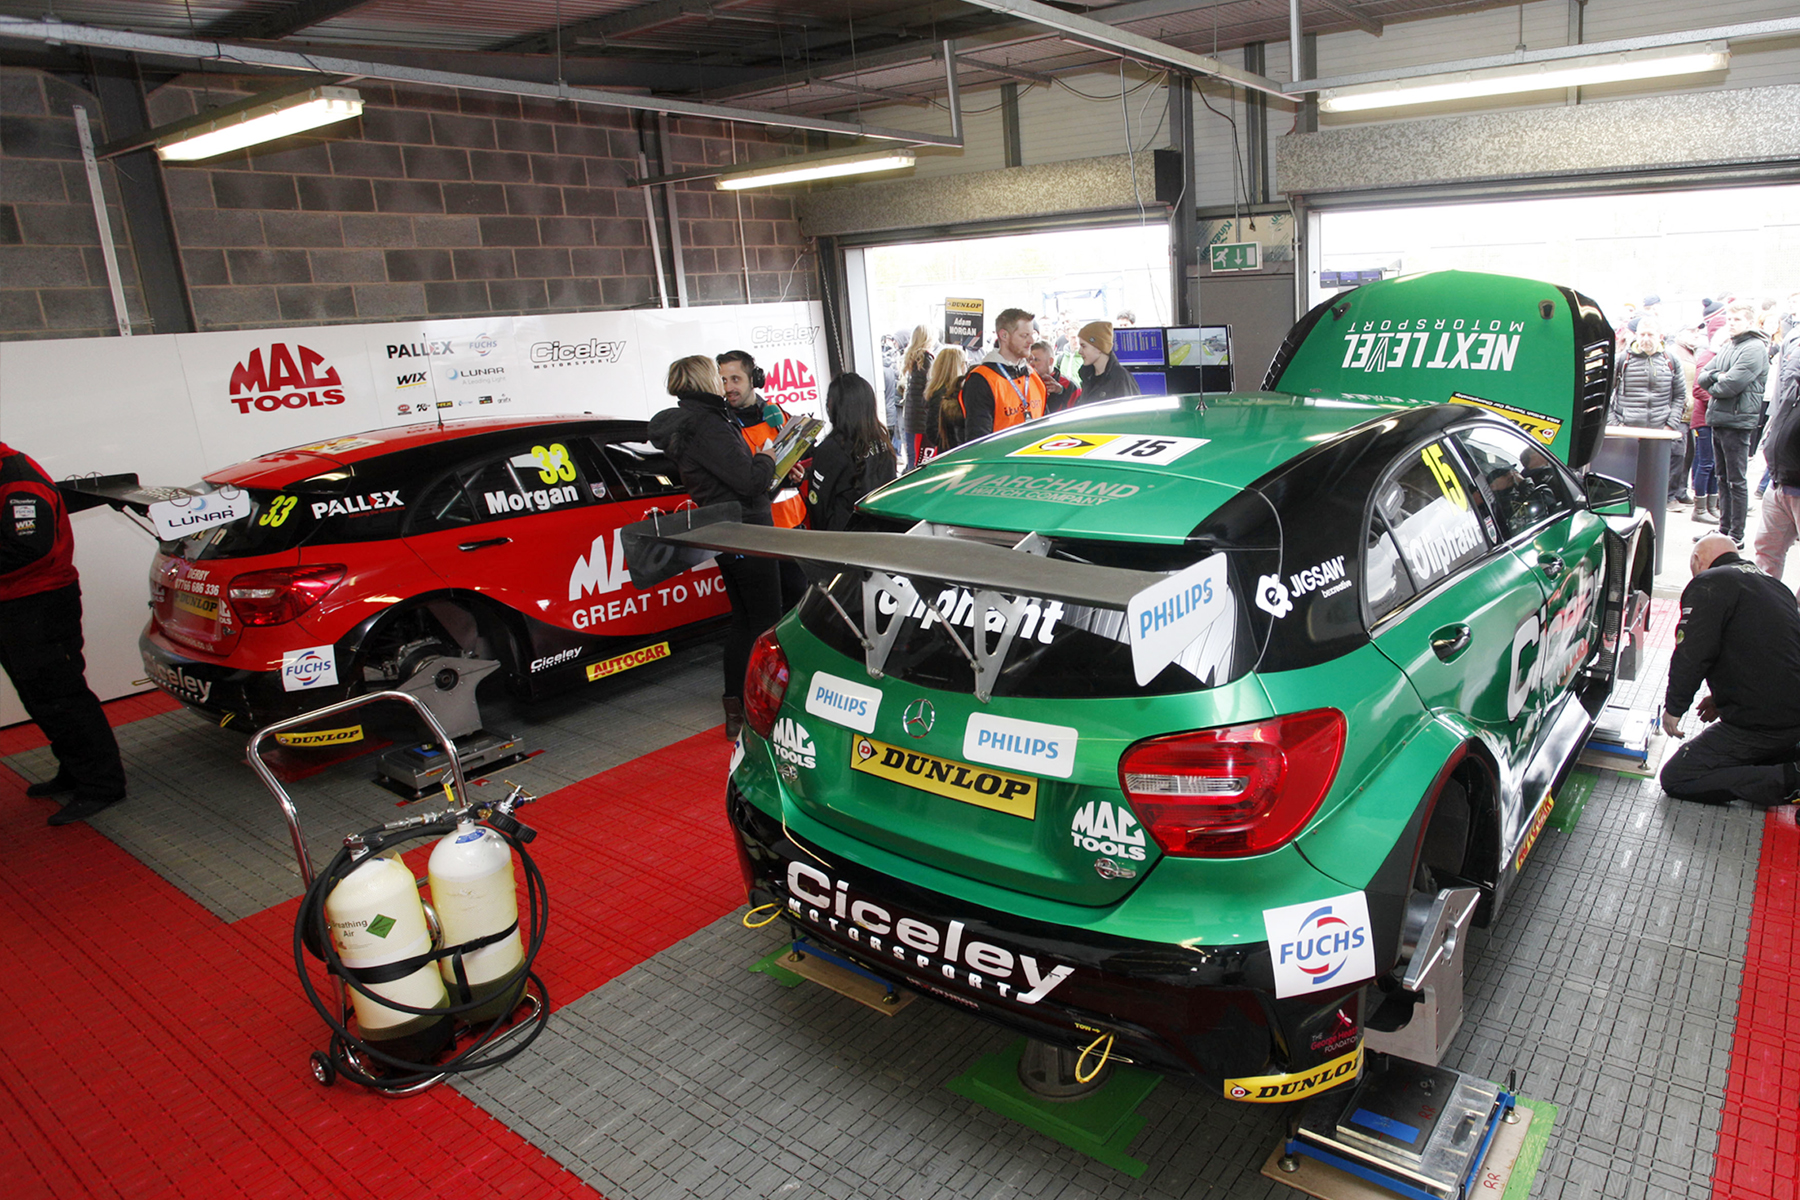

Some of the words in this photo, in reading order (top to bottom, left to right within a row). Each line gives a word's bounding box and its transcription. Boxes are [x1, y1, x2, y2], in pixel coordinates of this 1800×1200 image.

[951, 301, 982, 309] DUNLOP
[751, 323, 820, 346] Ciceley
[948, 325, 977, 336] MORGAN
[953, 317, 972, 327] Adam
[1347, 318, 1525, 333] MOTORSPORT
[469, 341, 498, 350] FUCHS
[530, 338, 627, 363] Ciceley
[1341, 332, 1431, 372] LEVEL
[1426, 332, 1521, 372] NEXT
[229, 343, 343, 396] MAC
[460, 366, 505, 378] LUNAR
[533, 359, 610, 369] MOTORSPORT
[764, 358, 817, 394] MAC
[397, 371, 427, 386] WIX
[231, 388, 346, 415] TOOLS
[765, 389, 818, 405] TOOLS
[1116, 439, 1177, 457] 15
[531, 443, 577, 485] 33
[924, 472, 1140, 499] MARCHAND
[1421, 443, 1469, 516] 15
[311, 490, 405, 519] PALLEX
[484, 483, 579, 515] Morgan
[971, 486, 1025, 498] WATCH
[1025, 488, 1110, 506] COMPANY
[15, 520, 35, 530] WIX
[168, 509, 235, 528] LUNAR
[259, 495, 298, 528] 33
[1409, 522, 1484, 580] Oliphant
[186, 568, 211, 582] DERBY
[1290, 556, 1346, 598] JIGSAW
[180, 592, 218, 613] DUNLOP
[191, 582, 205, 594] 686
[204, 584, 220, 597] 336
[571, 593, 652, 630] GREAT
[657, 585, 689, 607] TO
[1139, 577, 1214, 640] PHILIPS
[285, 660, 332, 677] FUCHS
[530, 646, 583, 671] Ciceley
[594, 645, 666, 678] AUTOCAR
[815, 685, 868, 717] PHILIPS
[291, 728, 360, 745] DUNLOP
[772, 717, 817, 757] MAC
[976, 728, 1060, 760] PHILIPS
[773, 743, 817, 770] TOOLS
[880, 747, 1032, 801] DUNLOP
[1071, 800, 1146, 848] MAC
[1071, 830, 1146, 862] TOOLS
[343, 930, 354, 938] Air
[786, 860, 1076, 1005] Ciceley
[1279, 926, 1366, 965] FUCHS
[788, 897, 1012, 998] MOTORSPORT
[1418, 1104, 1437, 1121] RR
[1483, 1172, 1501, 1190] RR
